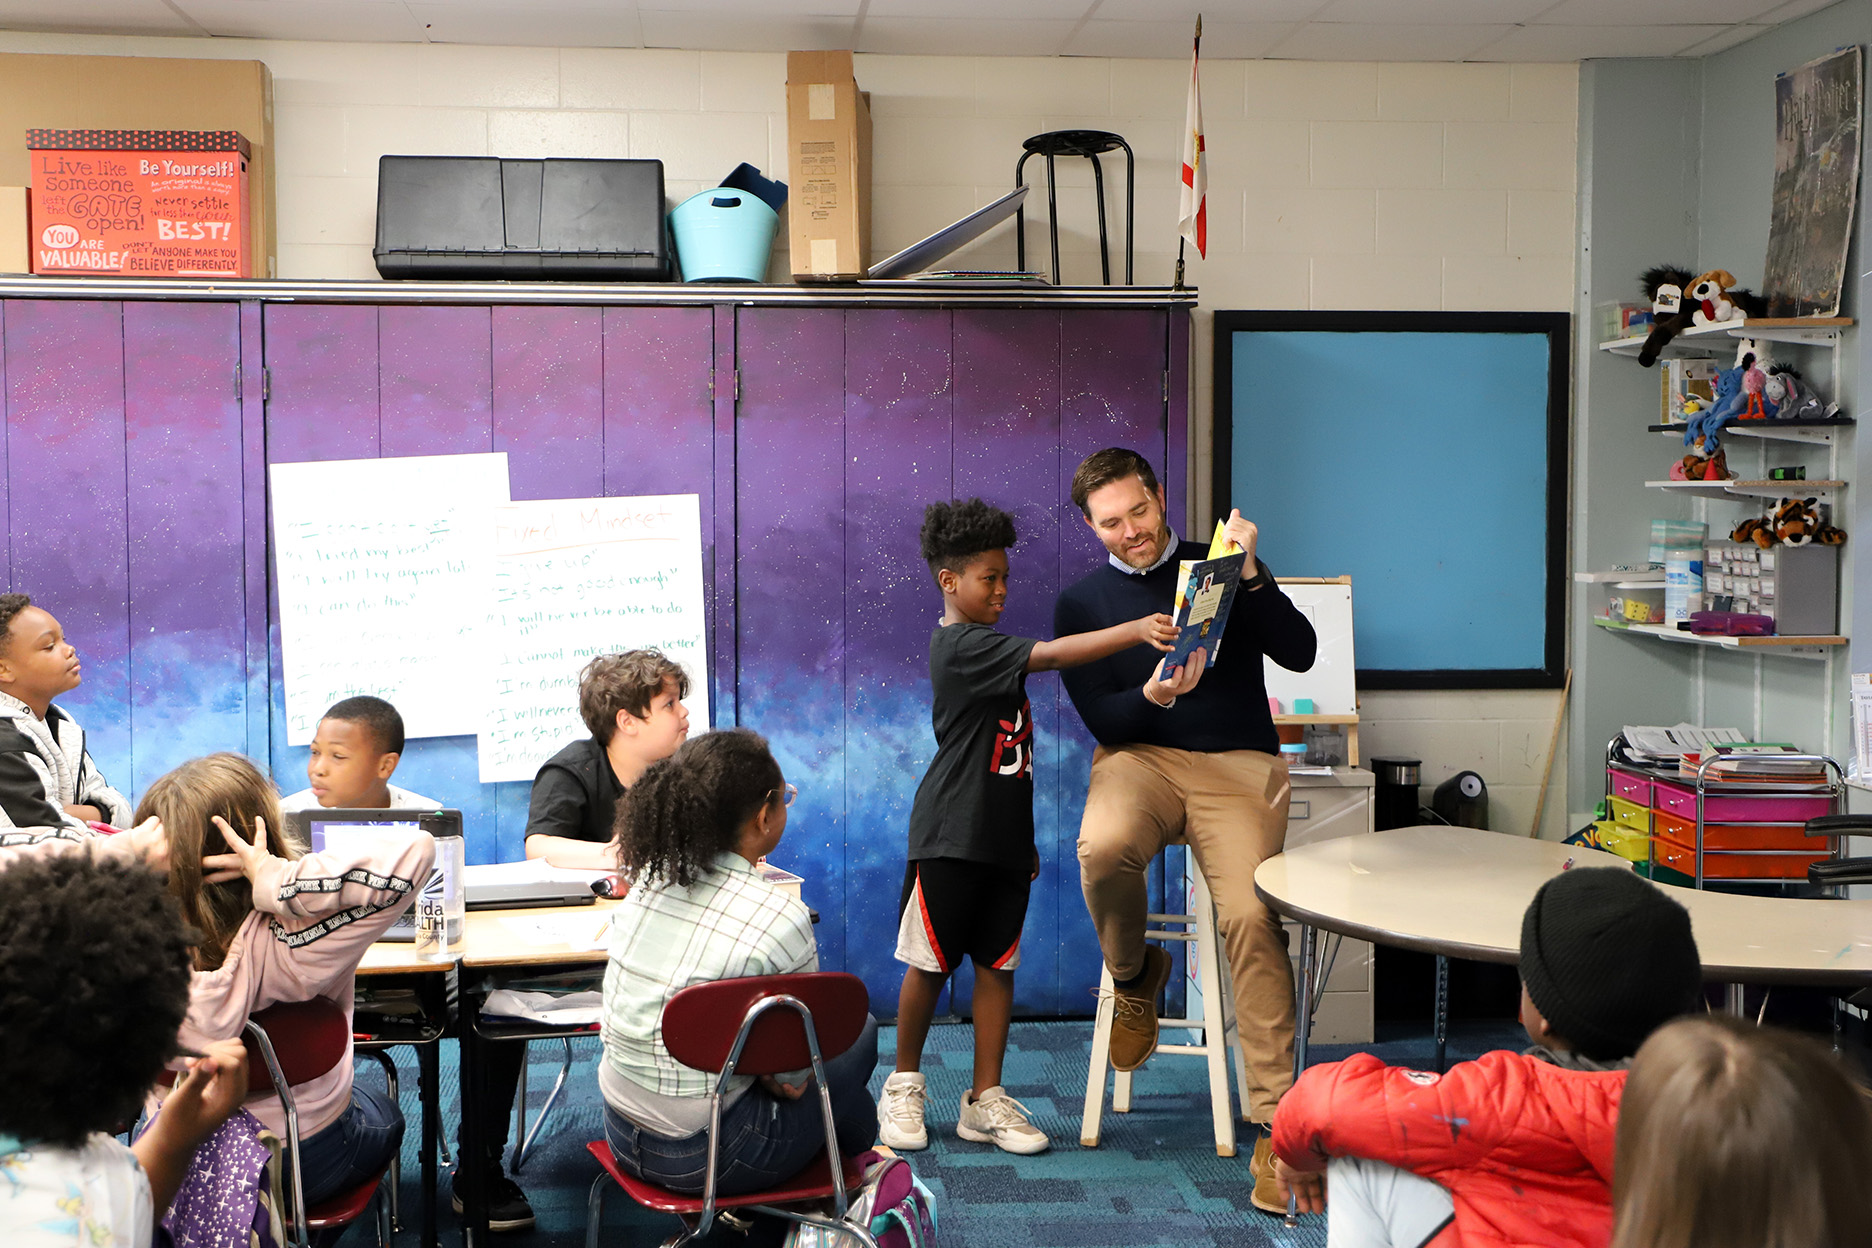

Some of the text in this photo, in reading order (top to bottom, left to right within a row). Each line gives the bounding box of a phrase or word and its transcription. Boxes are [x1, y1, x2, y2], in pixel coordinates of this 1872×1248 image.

[1815, 78, 1851, 127] Potter
[42, 156, 127, 176] Live like
[140, 160, 234, 177] Be Yourself!
[46, 176, 135, 192] Someone
[162, 178, 202, 186] original
[211, 180, 232, 190] always
[42, 193, 142, 218] left GATE
[46, 205, 66, 214] the
[155, 197, 230, 210] Never settle
[86, 214, 144, 236] open!
[163, 208, 177, 218] less
[179, 208, 194, 218] than
[196, 212, 236, 225] your
[157, 218, 232, 241] BEST!
[48, 229, 104, 250] YOU ARE
[122, 242, 154, 250] DON'T
[40, 250, 130, 270] VALUABLE!
[152, 248, 192, 257] ANYONE
[195, 248, 218, 257] MAKE
[221, 249, 237, 258] YOU
[580, 504, 672, 530] Mindset
[366, 549, 389, 560] my
[518, 612, 543, 624] will
[594, 606, 613, 616] be
[618, 605, 645, 616] able
[652, 604, 664, 614] to
[667, 602, 683, 614] do
[518, 648, 564, 664] cannot
[574, 646, 604, 658] make
[416, 916, 444, 930] ALTH
